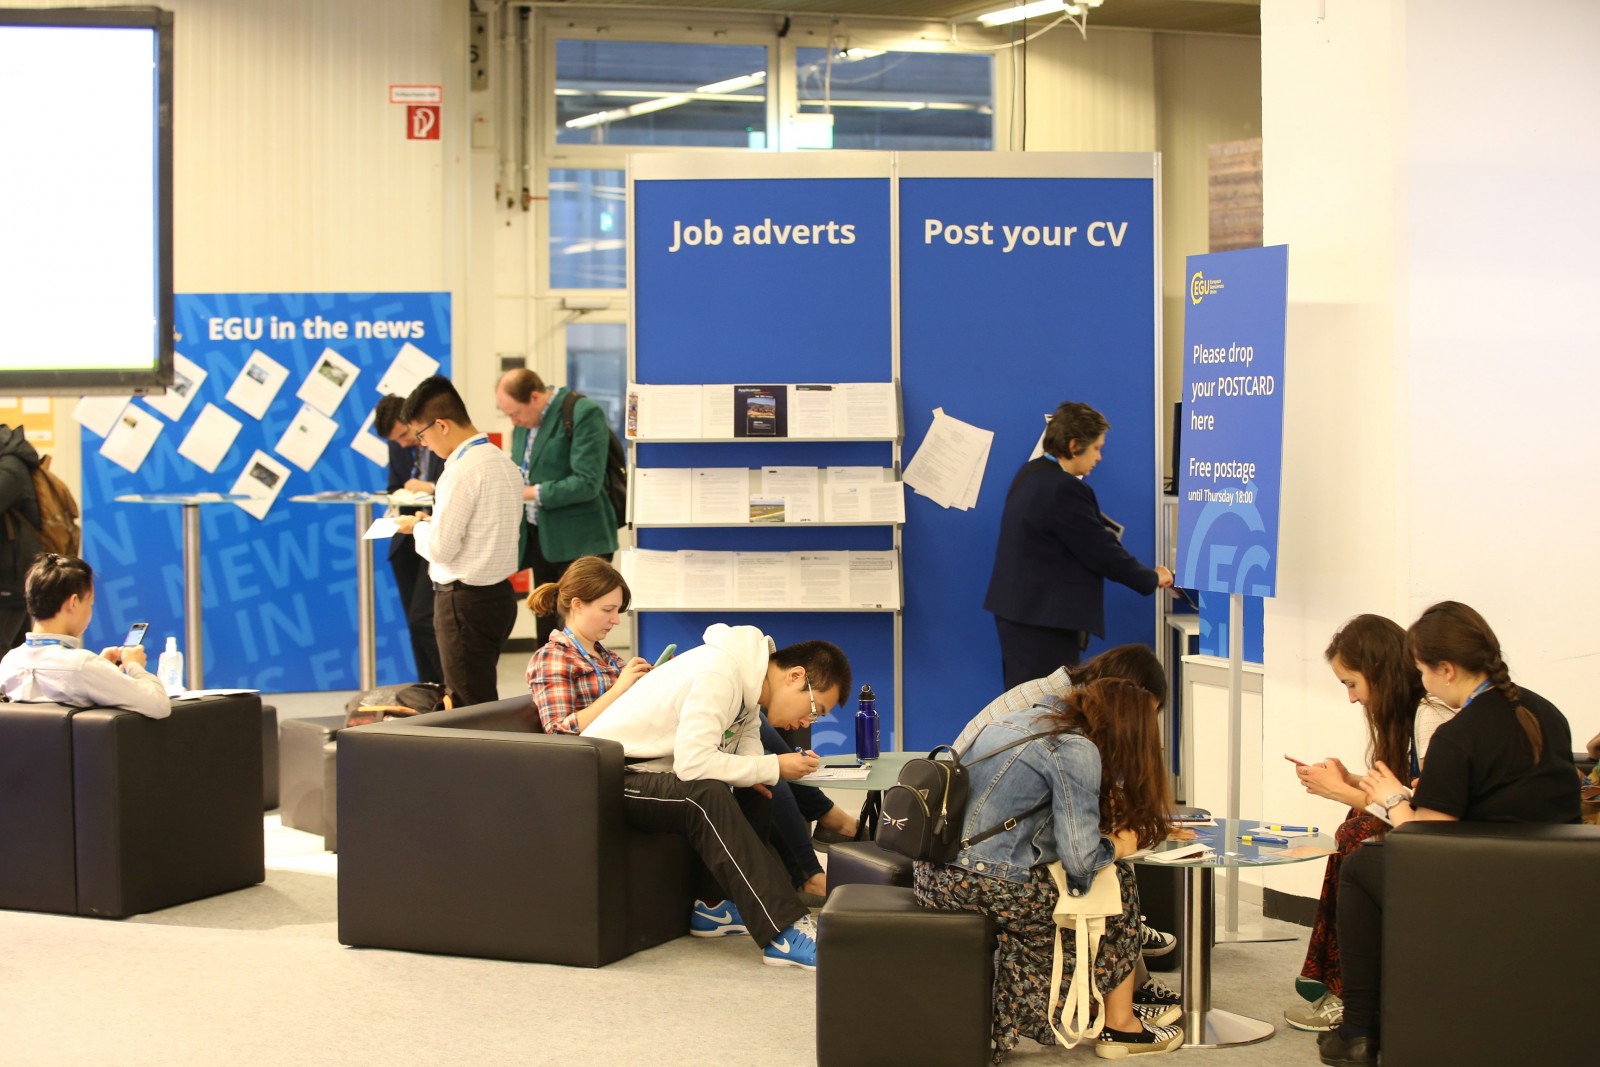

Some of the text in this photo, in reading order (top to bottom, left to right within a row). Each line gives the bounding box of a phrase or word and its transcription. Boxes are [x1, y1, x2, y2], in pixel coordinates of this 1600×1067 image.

[668, 218, 856, 253] Job adverts
[924, 219, 1129, 253] Post your CV
[1194, 279, 1210, 296] EGU
[208, 315, 425, 341] EGU in the news
[1193, 342, 1254, 369] Please drop
[1191, 375, 1275, 404] your POSTCARD
[1190, 409, 1215, 431] here
[1189, 457, 1256, 484] Free postage
[1187, 488, 1253, 507] until Thursday 18:00
